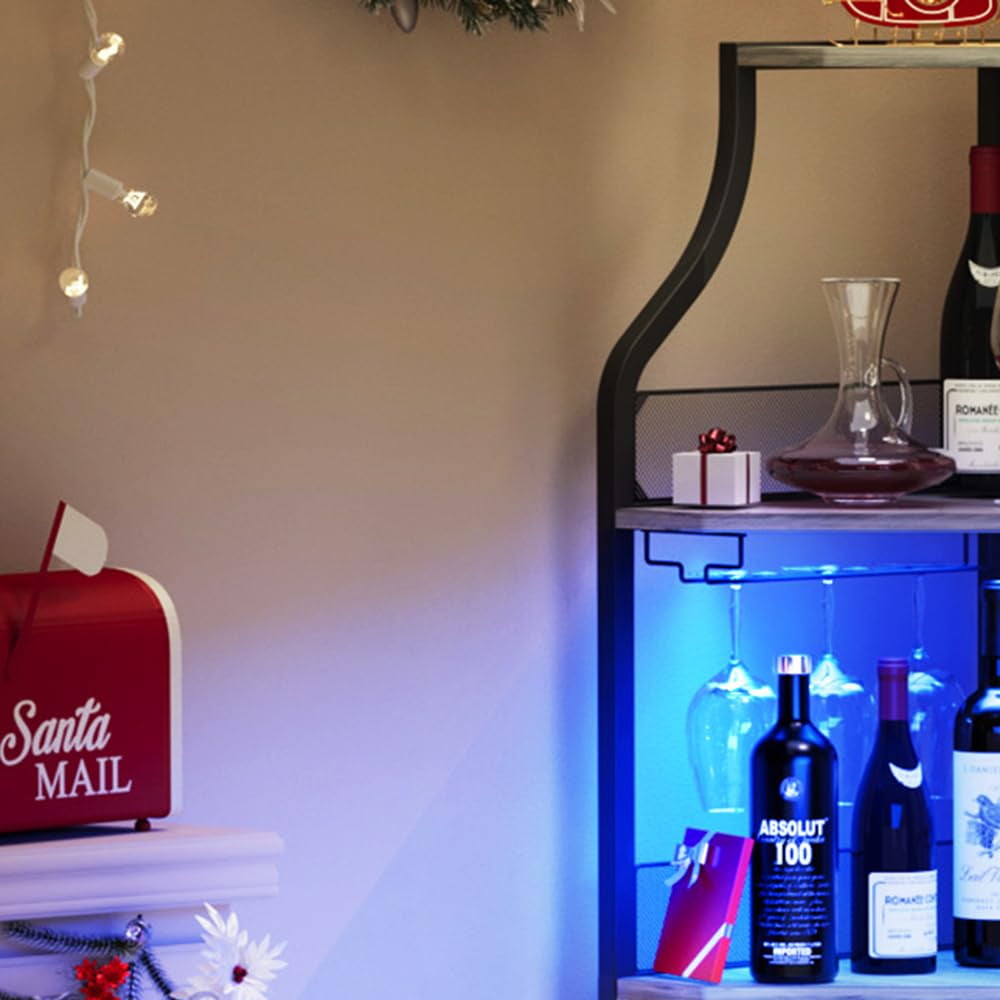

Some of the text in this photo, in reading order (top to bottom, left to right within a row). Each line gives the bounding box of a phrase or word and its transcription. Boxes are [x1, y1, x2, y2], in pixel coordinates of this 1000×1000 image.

[0, 697, 112, 766] Santa
[35, 755, 133, 801] MAIL
[759, 819, 827, 837] ABSOLUT
[775, 842, 813, 866] 100
